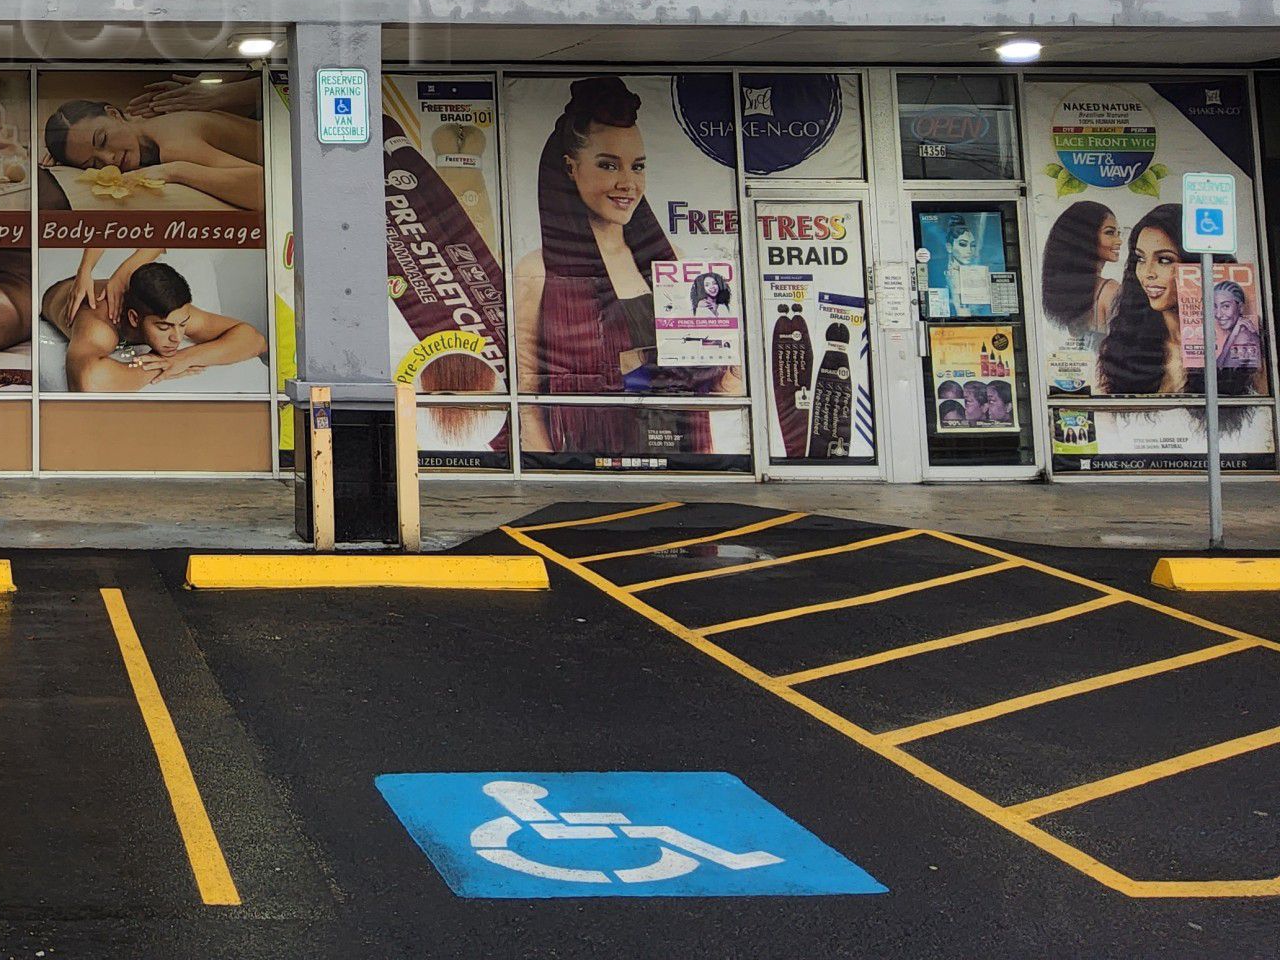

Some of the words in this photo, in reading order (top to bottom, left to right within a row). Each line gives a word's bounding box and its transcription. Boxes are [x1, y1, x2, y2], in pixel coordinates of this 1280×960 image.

[321, 76, 363, 85] RESERVED
[324, 87, 361, 96] PARKING
[1063, 103, 1101, 112] NAKED
[1102, 103, 1142, 112] NATURE
[334, 116, 353, 125] VAN
[440, 114, 472, 122] BRAID
[323, 126, 365, 136] ACCESSIBLE
[1055, 136, 1084, 147] LACE
[1088, 136, 1128, 147] FRONT
[1132, 136, 1155, 147] WIG
[920, 145, 946, 157] 14356
[1100, 163, 1141, 184] WAVY
[43, 221, 155, 244] Body-Foot
[164, 222, 261, 244] Massage
[768, 246, 848, 265] BRAID
[830, 313, 851, 321] BRAID
[397, 332, 479, 384] Pre-Stretched
[447, 458, 481, 467] DEALER
[1150, 460, 1209, 469] AUTHORIZED
[1221, 460, 1248, 469] EALER
